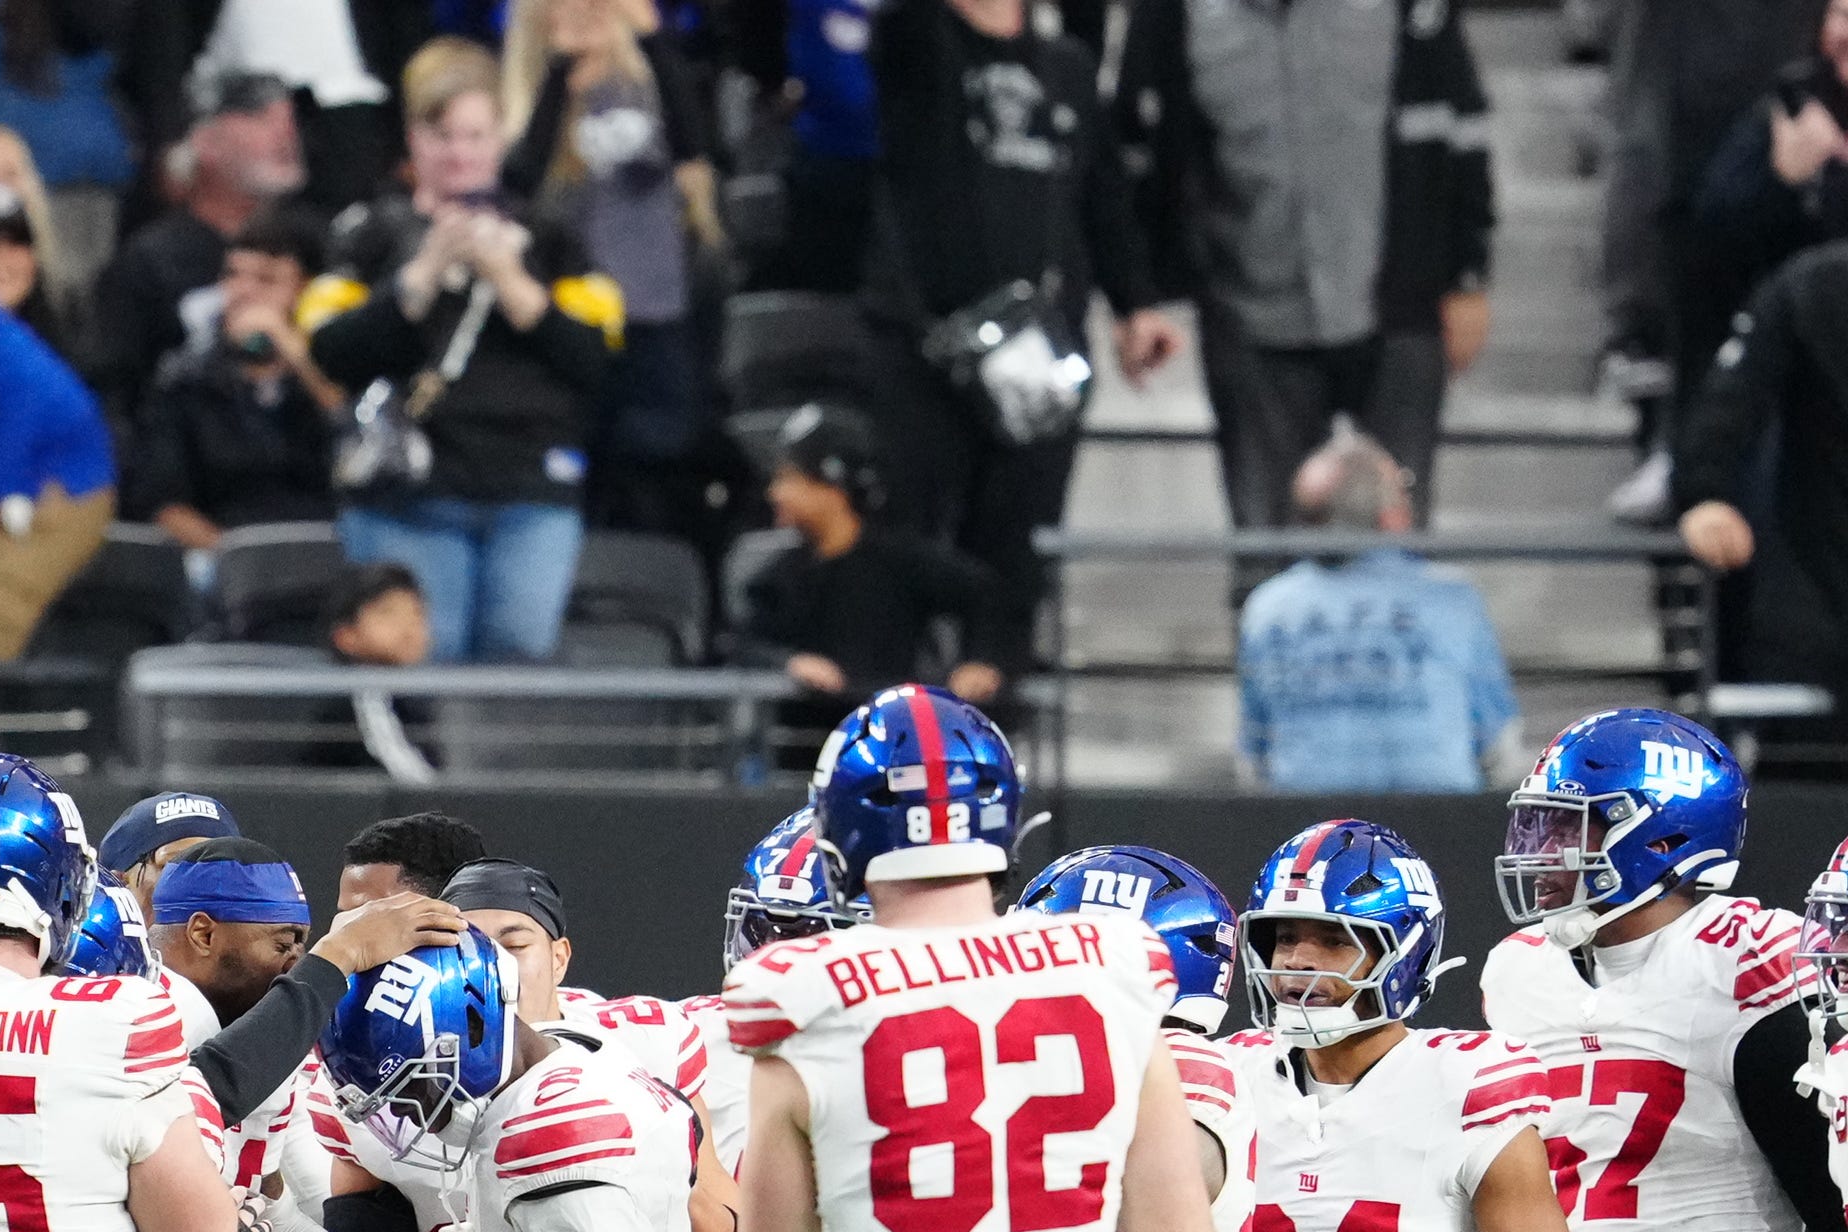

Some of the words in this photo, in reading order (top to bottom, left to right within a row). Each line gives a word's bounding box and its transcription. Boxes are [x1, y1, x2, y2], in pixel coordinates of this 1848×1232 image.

[155, 798, 219, 820] GIANTS
[907, 803, 970, 843] 82
[763, 849, 818, 879] 71
[826, 922, 1105, 1008] BELLINGER
